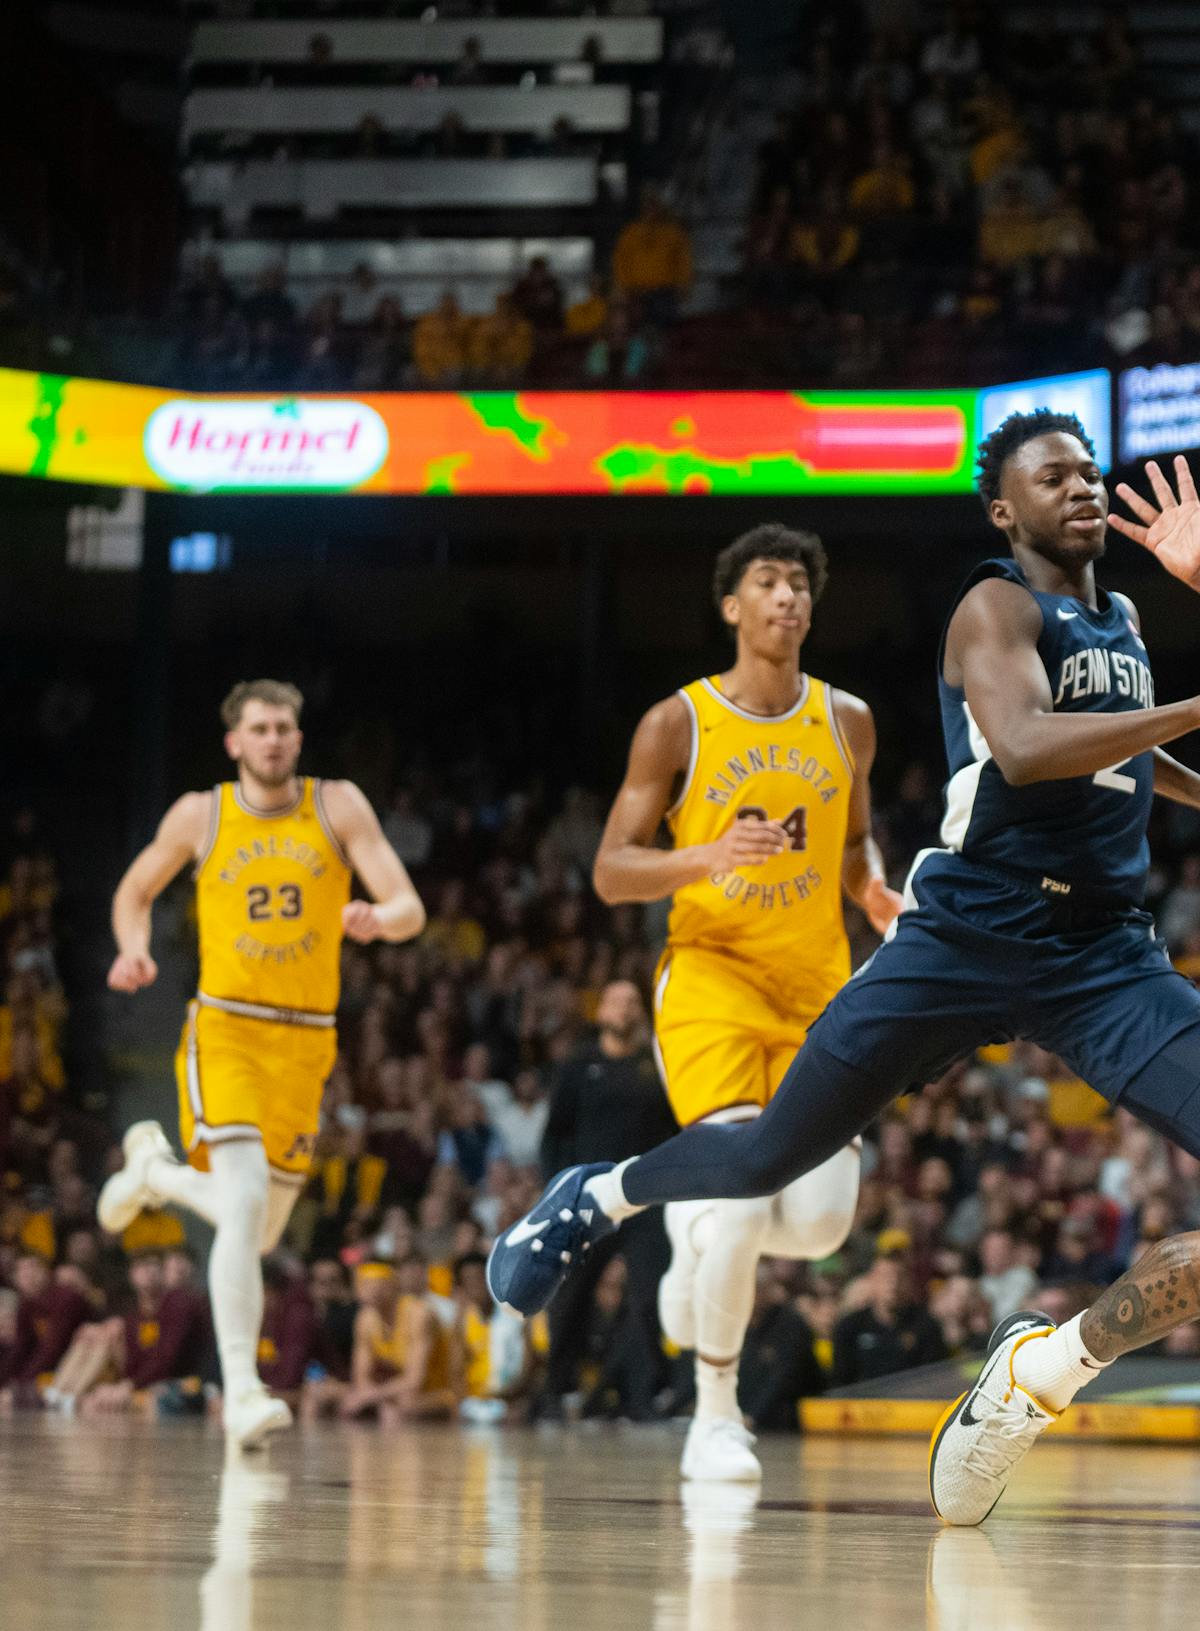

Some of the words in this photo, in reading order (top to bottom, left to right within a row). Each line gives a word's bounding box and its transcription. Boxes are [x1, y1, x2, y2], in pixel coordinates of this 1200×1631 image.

[1053, 647, 1112, 706] PENN
[1110, 651, 1155, 710] STAT
[704, 743, 841, 807] MINNESOTA
[246, 883, 303, 922] 23
